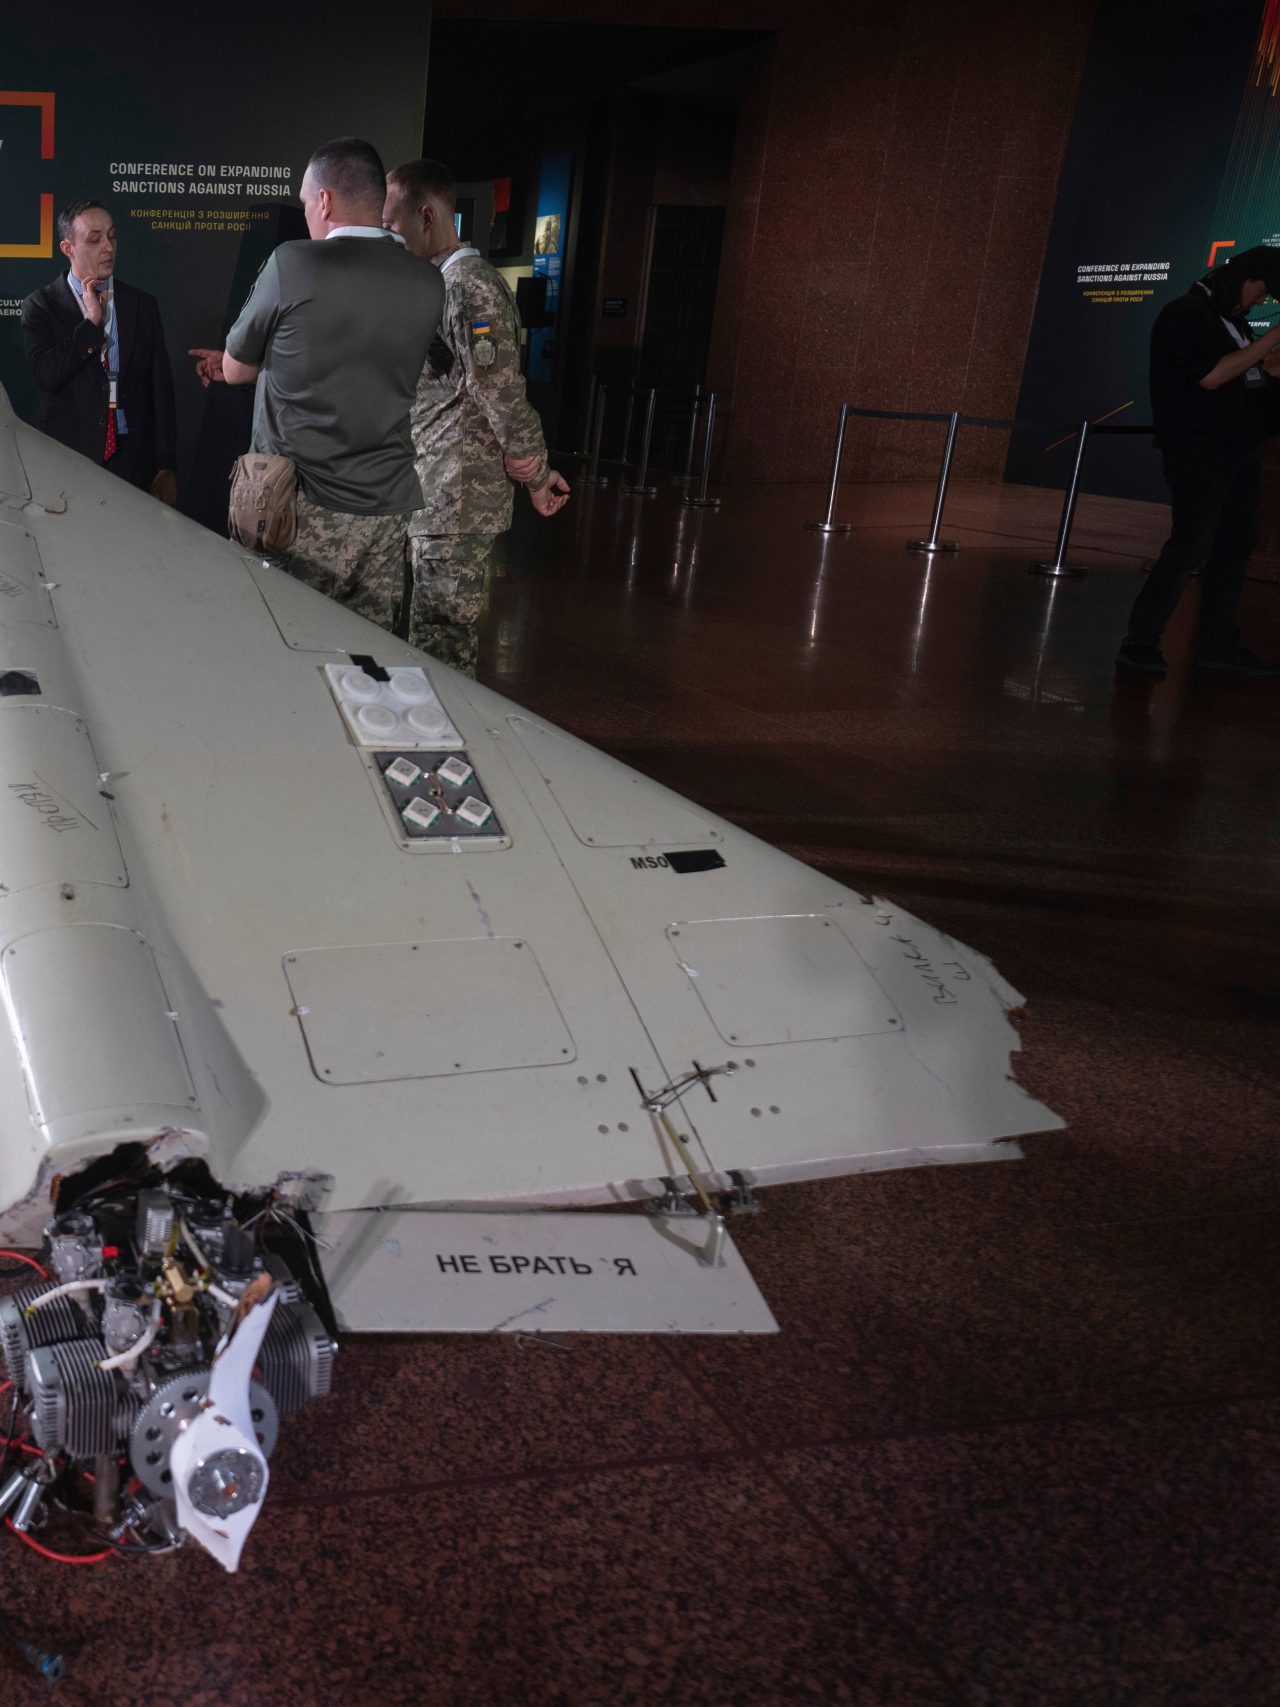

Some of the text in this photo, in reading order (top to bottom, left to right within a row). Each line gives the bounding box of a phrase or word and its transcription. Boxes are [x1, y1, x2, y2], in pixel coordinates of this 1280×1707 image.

[109, 162, 291, 179] CONFERENCE ON EXPANDING
[112, 180, 291, 196] SANCTIONS AGAINST RUSSIA
[130, 209, 195, 220] КОНФЕРЕНЦІЯ
[207, 210, 270, 220] РОЗШИРЕННЯ
[151, 220, 192, 231] САНКЦІЙ
[194, 222, 225, 231] ПРОТИ
[1077, 262, 1170, 273] CONFERENCE ON EXPANDING
[1077, 272, 1168, 283] SANCTIONS AGAINST RUSSIA
[436, 1254, 482, 1274] НЕ
